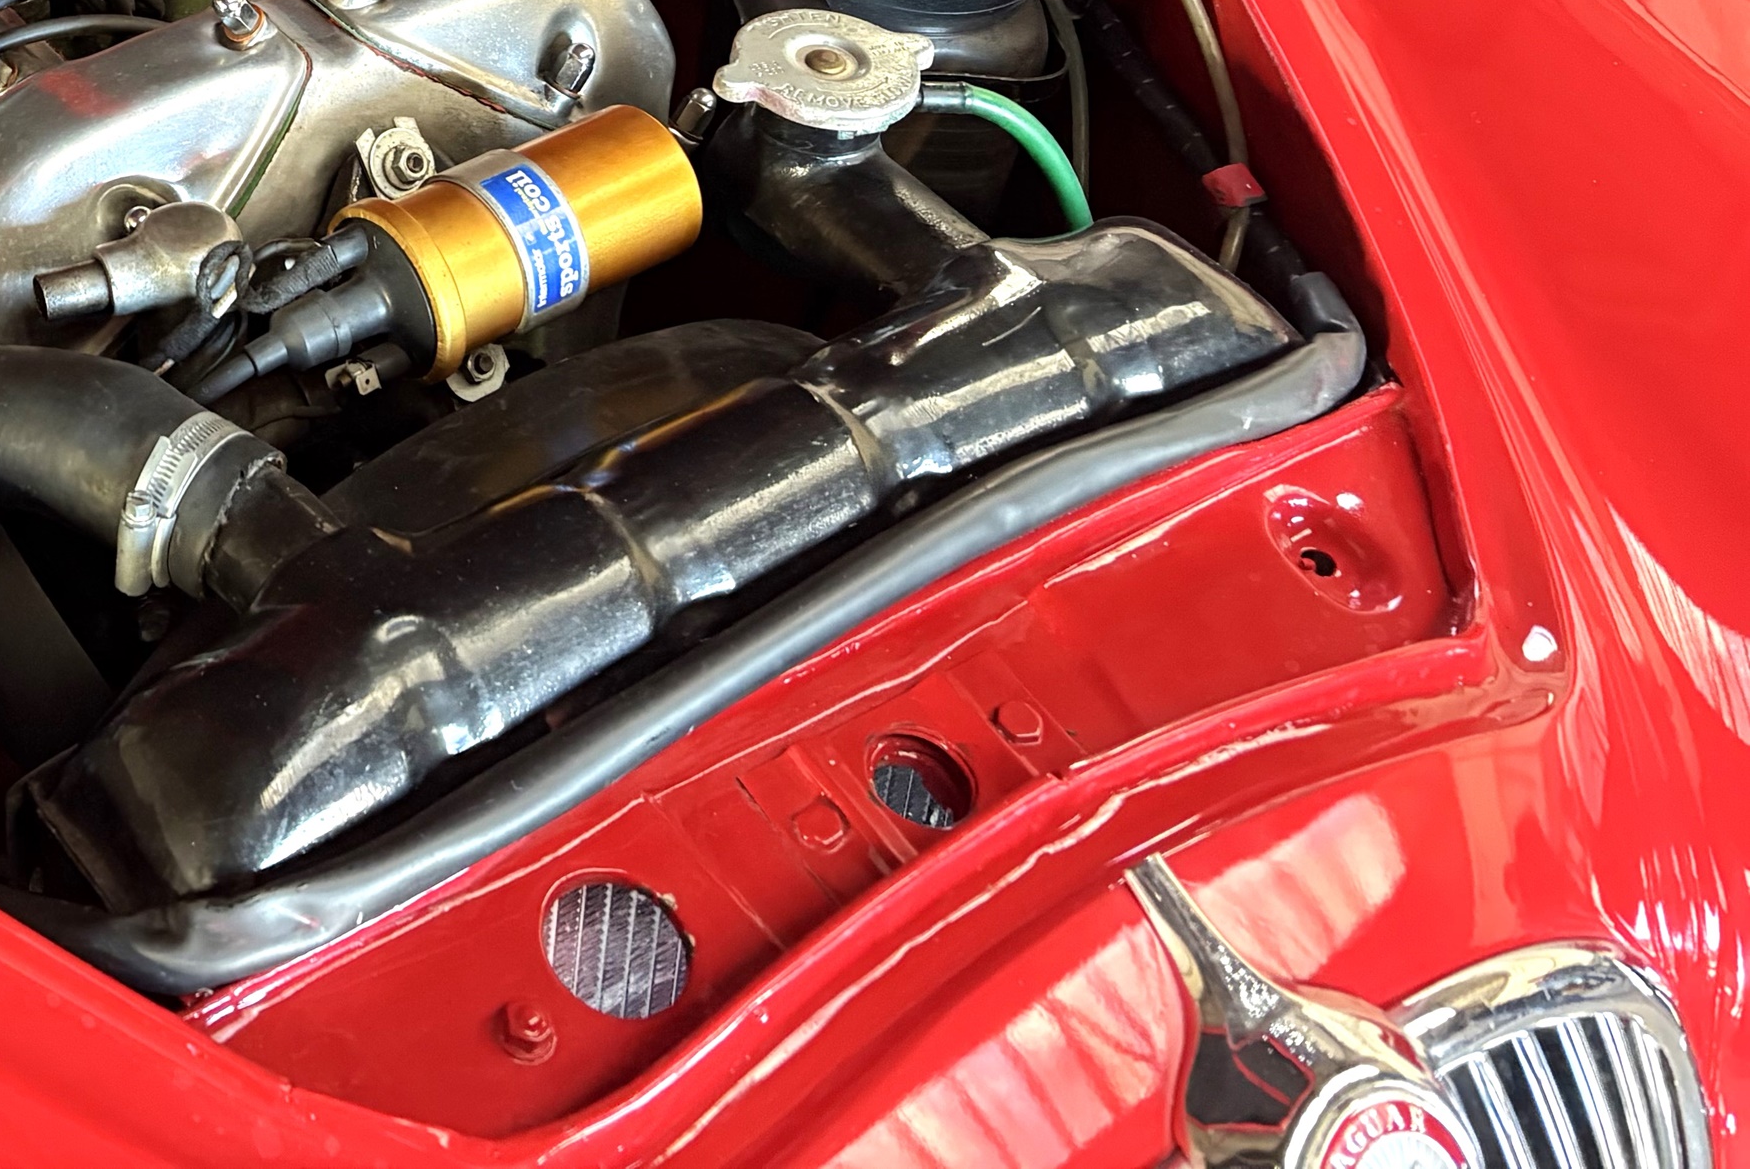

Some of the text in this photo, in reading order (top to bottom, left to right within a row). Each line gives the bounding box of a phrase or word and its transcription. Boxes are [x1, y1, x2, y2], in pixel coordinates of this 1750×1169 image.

[505, 170, 579, 297] sports coil
[531, 249, 548, 308] Intermotor
[1329, 1103, 1427, 1169] AGUAR
